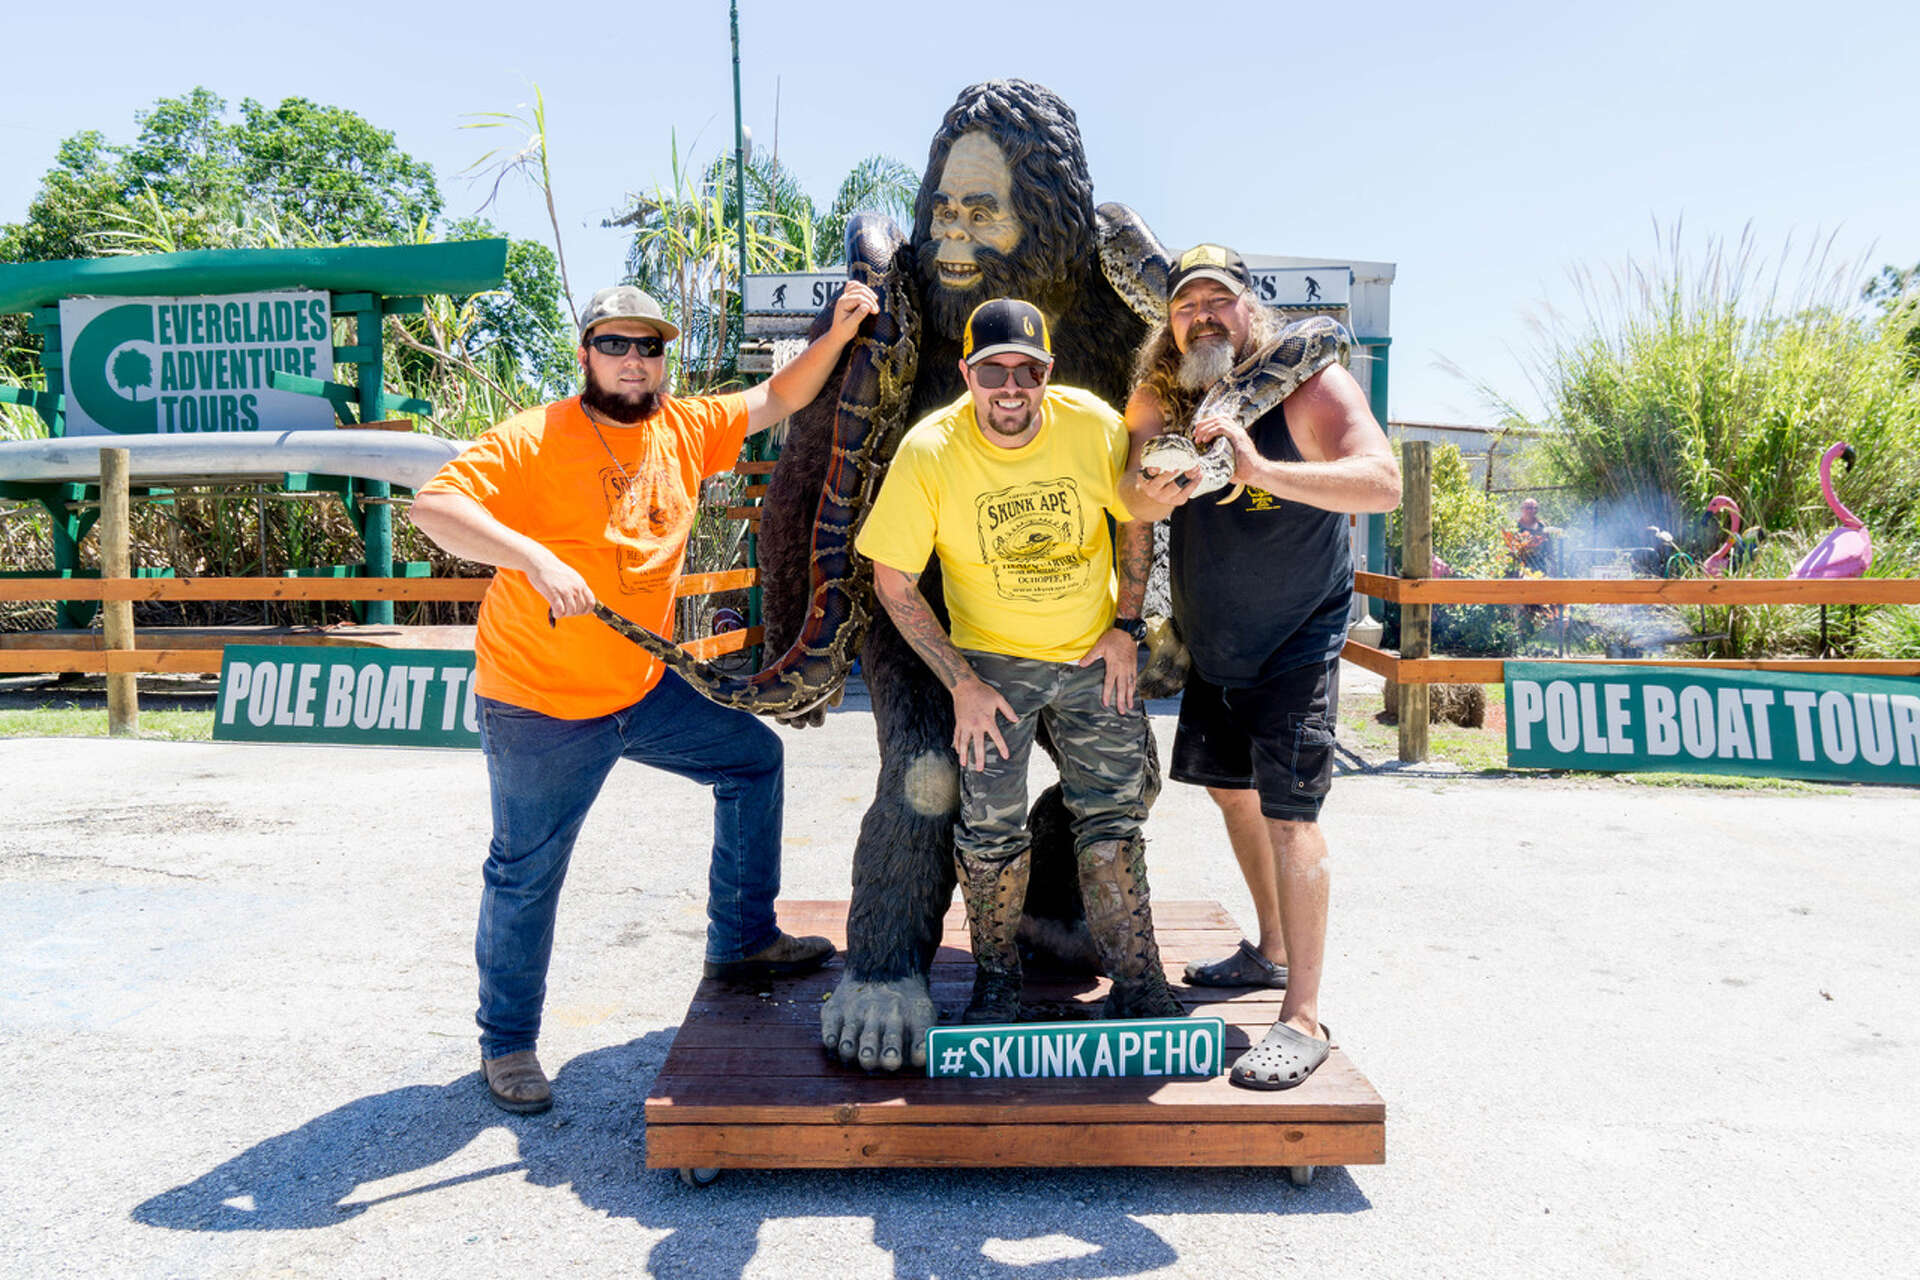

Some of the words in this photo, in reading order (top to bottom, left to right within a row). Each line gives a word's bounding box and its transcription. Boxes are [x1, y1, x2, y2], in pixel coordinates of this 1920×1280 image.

[158, 299, 328, 345] EVERGLADES
[160, 347, 317, 391] ADVENTURE
[161, 394, 260, 433] TOURS
[988, 498, 1035, 531] SKUNK
[1040, 491, 1071, 515] APE
[222, 661, 321, 727] POLE
[324, 664, 435, 730] BOAT
[1512, 680, 1635, 755] POLE
[1642, 685, 1775, 760] BOAT
[1783, 690, 1920, 767] TOUR
[939, 1029, 1213, 1078] #SKUNKAPEHQ
